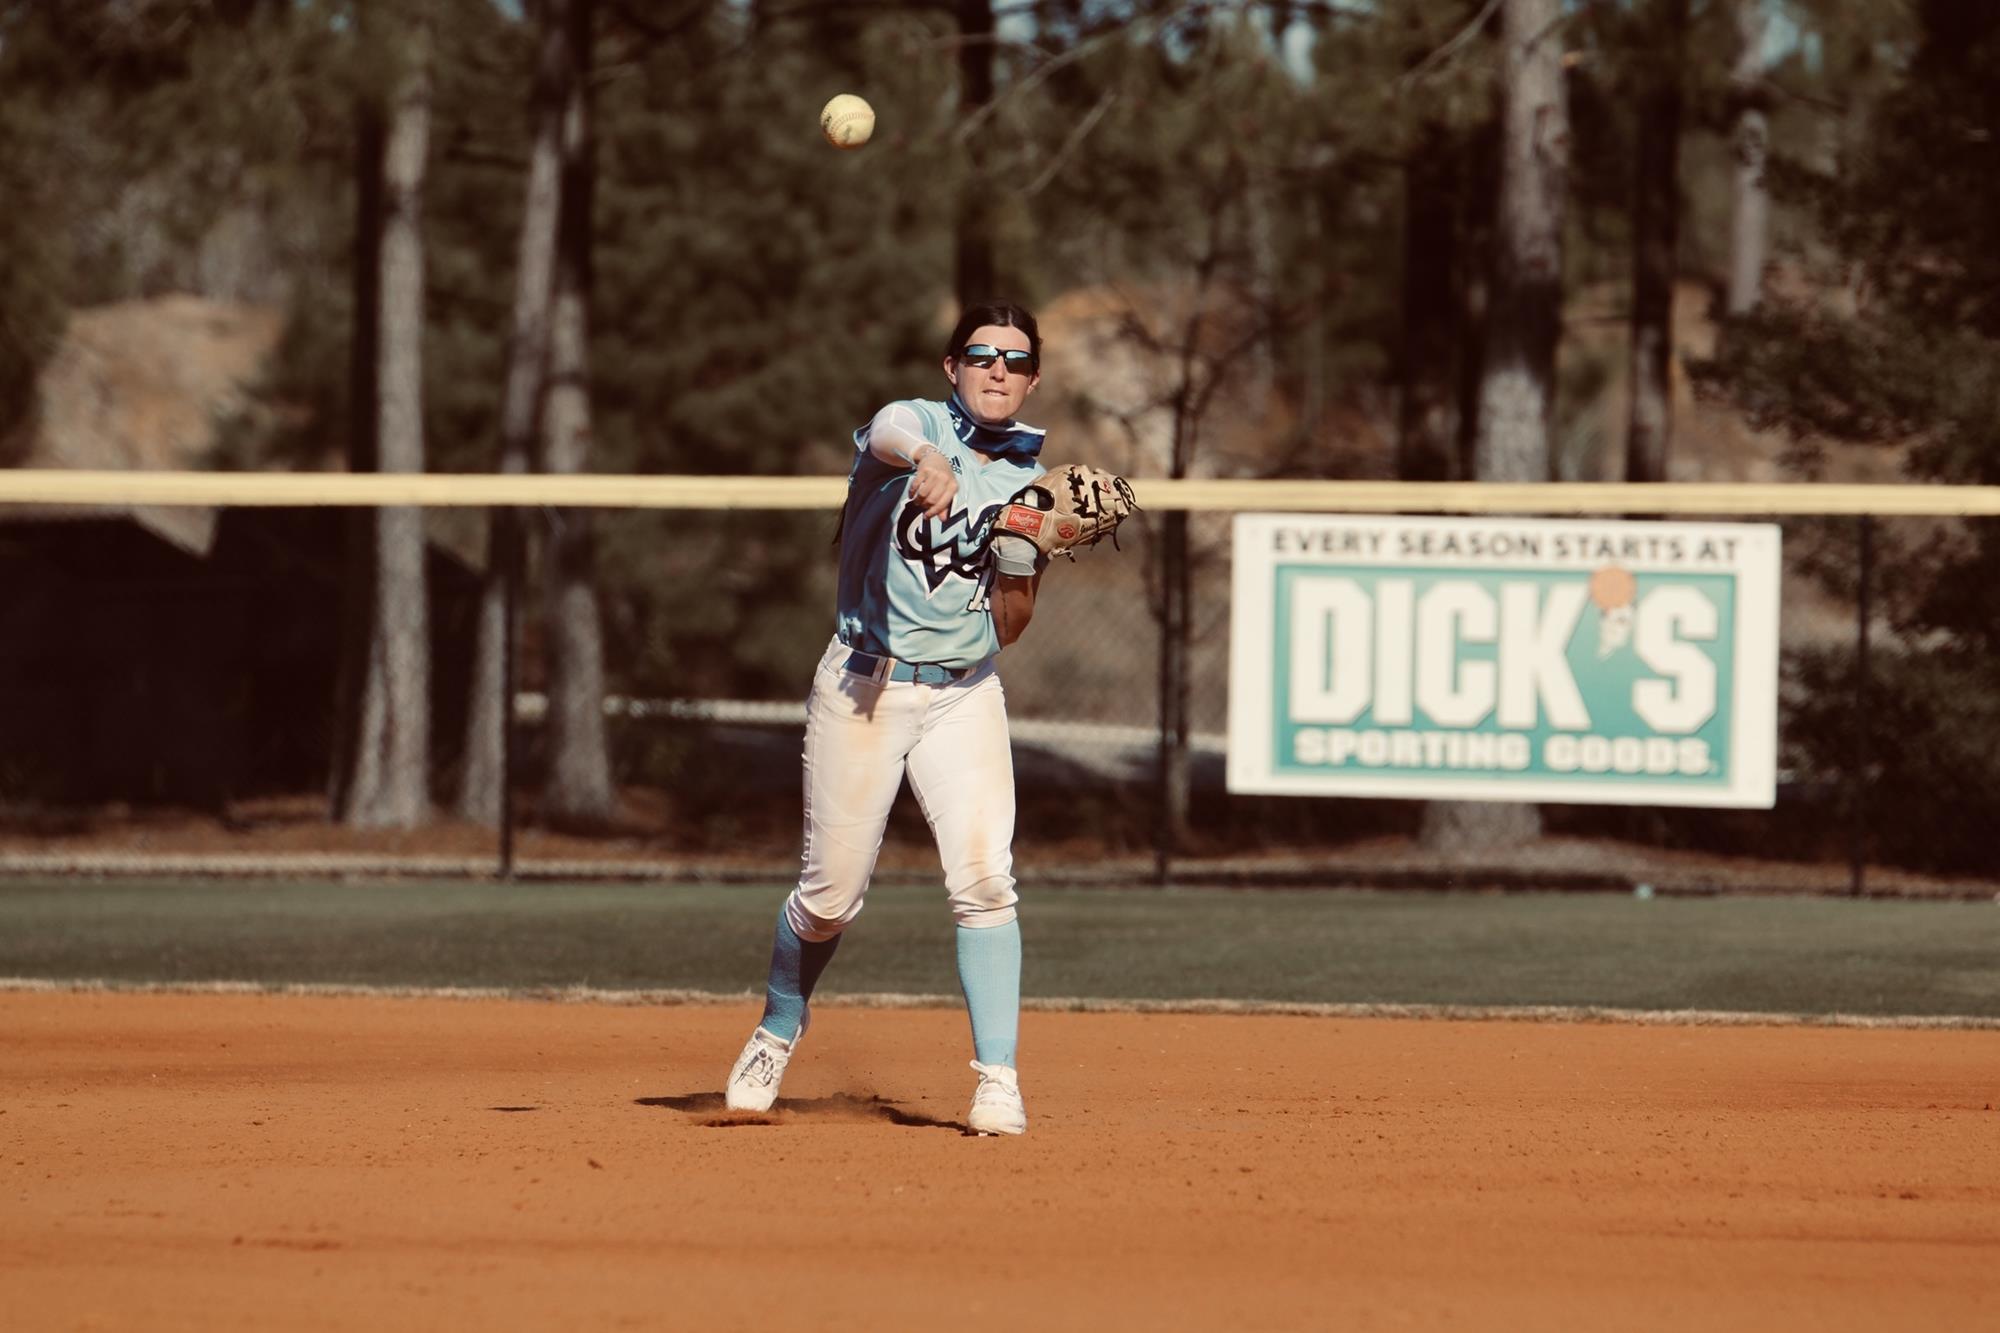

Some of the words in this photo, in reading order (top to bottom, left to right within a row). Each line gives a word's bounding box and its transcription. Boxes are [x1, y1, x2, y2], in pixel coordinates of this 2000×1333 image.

[1273, 528, 1384, 554] EVERY
[1399, 529, 1540, 558] SEASON
[1554, 533, 1684, 562] STARTS
[1698, 536, 1740, 562] AT
[1289, 576, 1719, 733] DICK'S
[1294, 729, 1530, 771] SPORTING
